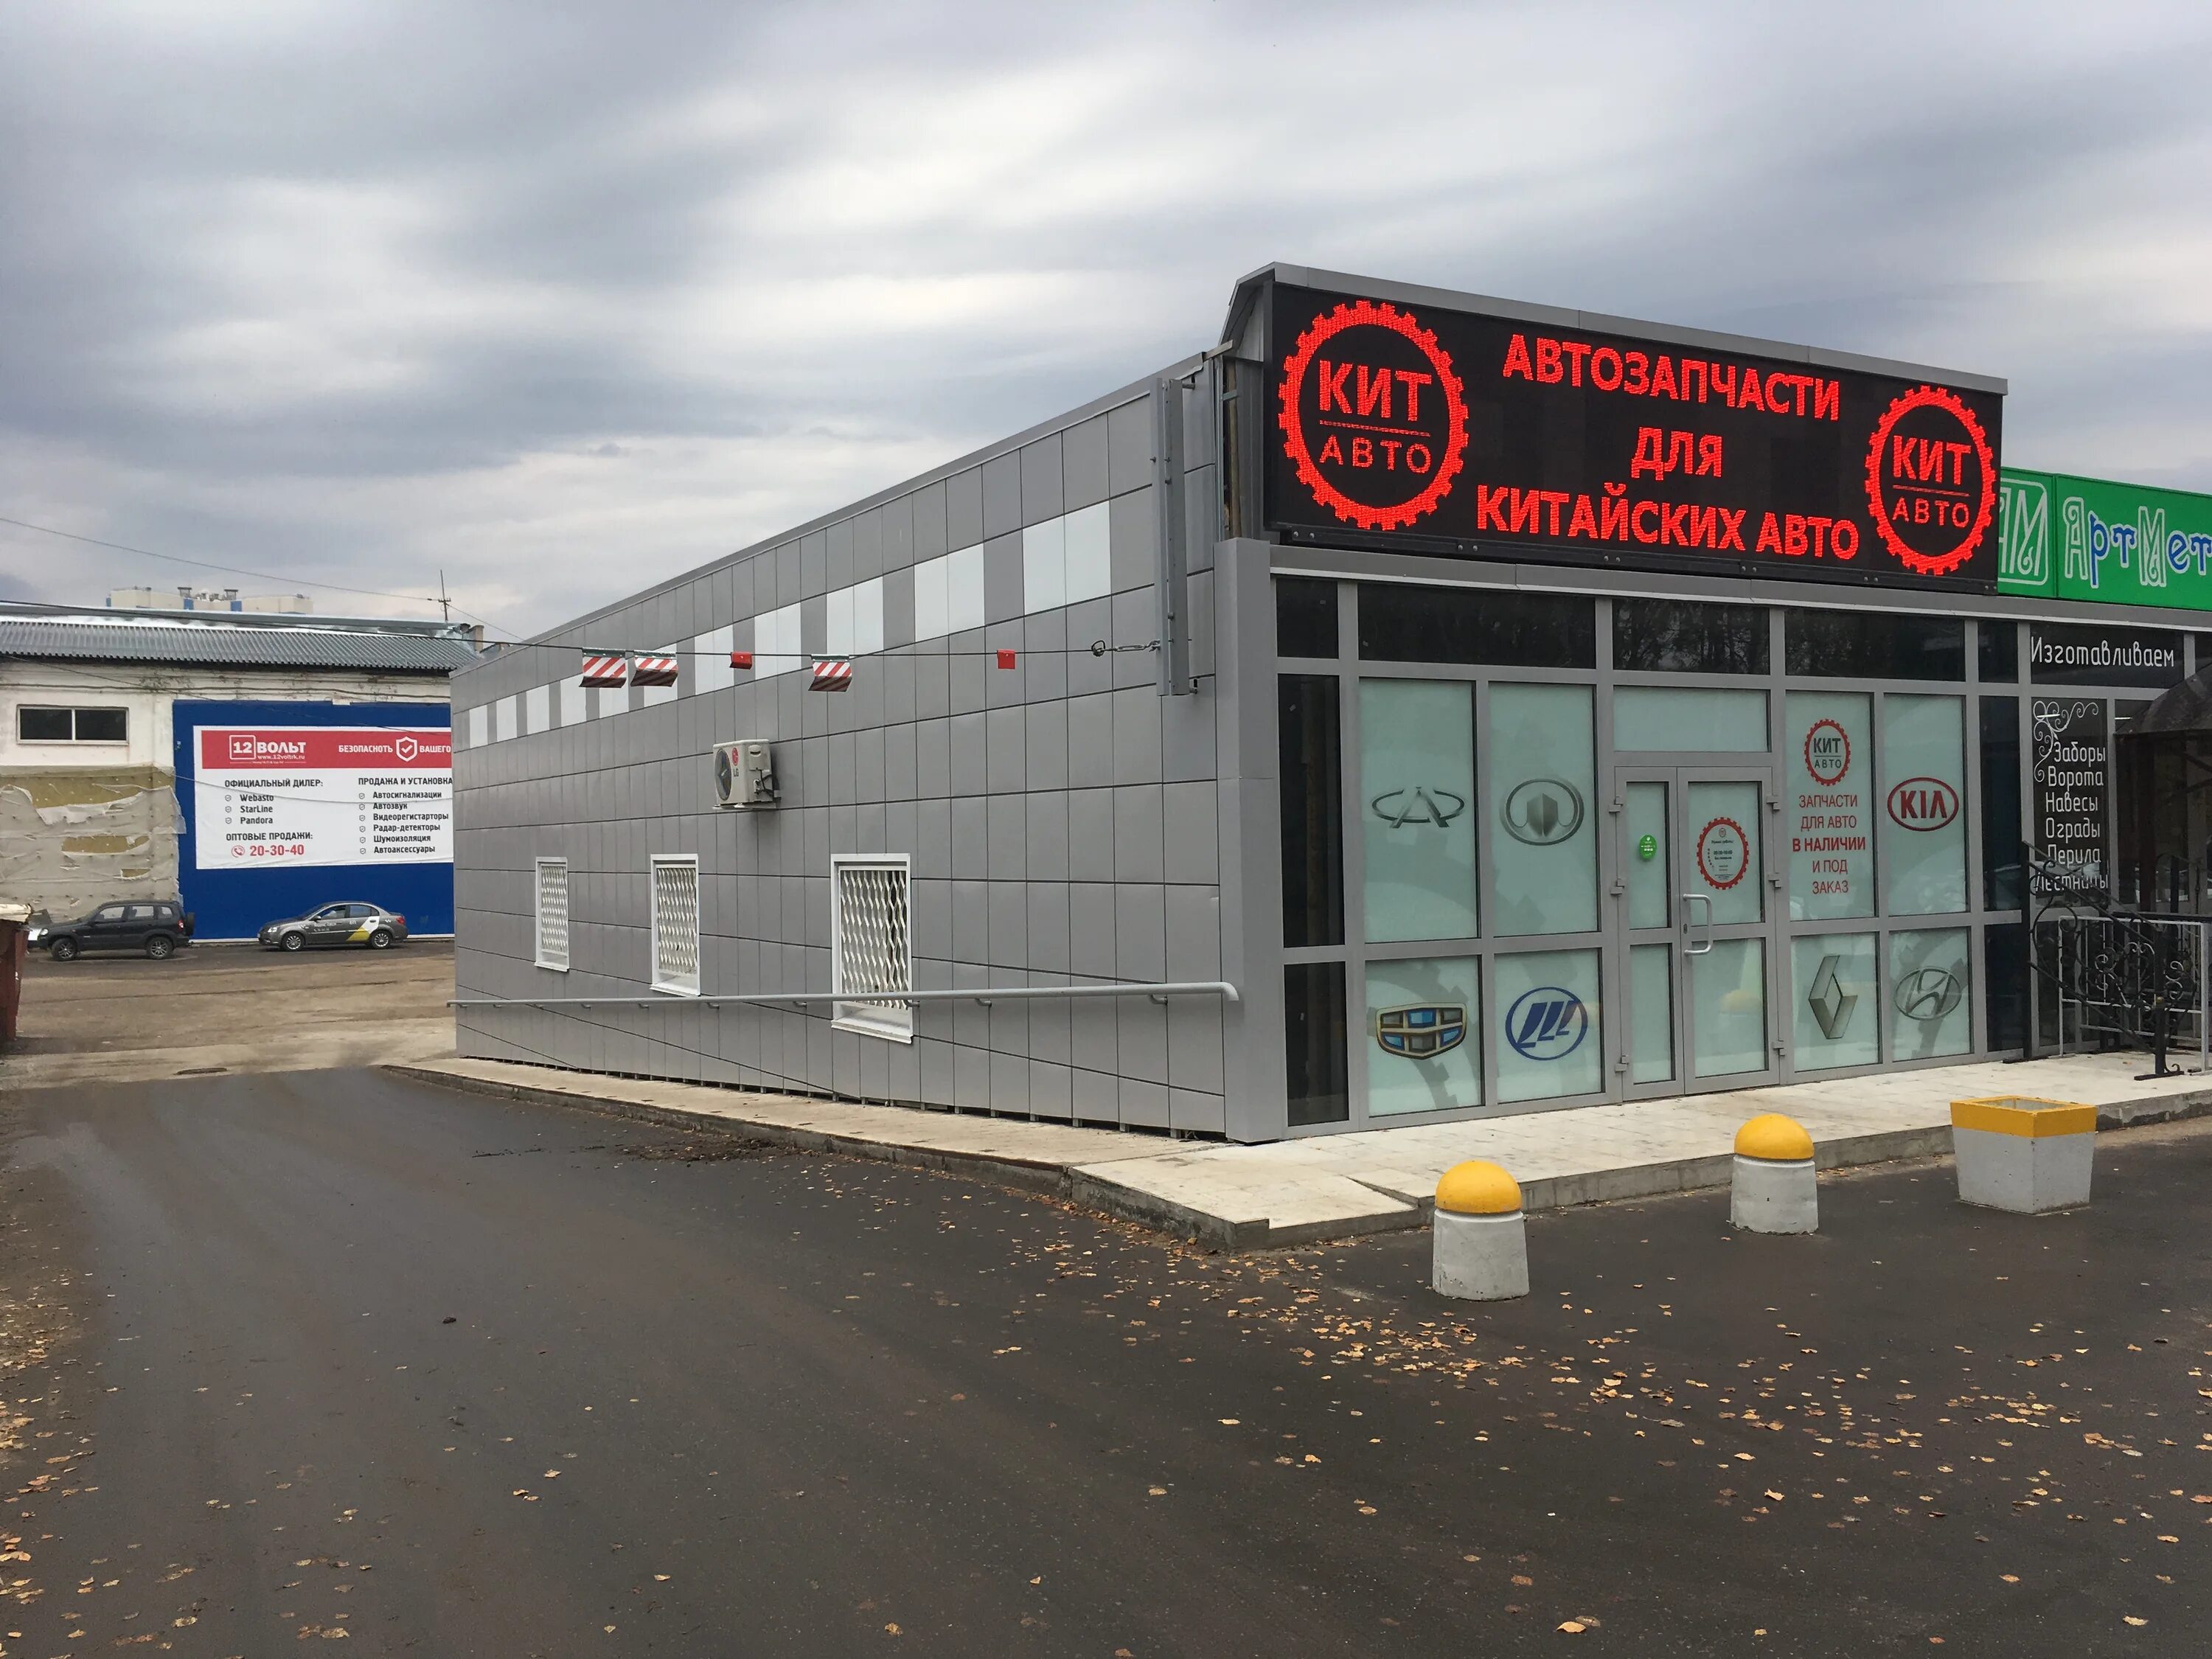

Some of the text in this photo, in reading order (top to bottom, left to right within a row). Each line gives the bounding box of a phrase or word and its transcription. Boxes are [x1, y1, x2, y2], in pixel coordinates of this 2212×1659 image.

[1502, 333, 1840, 421] АВТОЗАПЧАСТИ
[1318, 360, 1432, 423] КИТ
[1318, 436, 1432, 474] АВТО
[1630, 426, 1722, 481] ДЛЯ
[1893, 435, 1971, 485] КИТ
[1892, 497, 1970, 528] АВТО
[1477, 481, 1860, 560] КИТАЙСКИХ АВТО
[2031, 636, 2174, 667] Изготавливаем
[233, 741, 307, 754] 12 ВОЛЬТ
[338, 745, 451, 753] БЕЗОПАСНОТЬ ВАШЕГО
[1813, 737, 1841, 754] КИТ
[2053, 741, 2106, 767] Заборы
[1814, 759, 1842, 768] АВТО
[733, 768, 739, 777] LG
[2048, 765, 2104, 791] Ворота
[224, 779, 324, 788] ОФИЦИАЛЬНЫЙ ДИЛЕР:
[358, 777, 398, 786] ПРОДАЖА
[408, 776, 452, 785] УСТАНОВКА
[240, 794, 274, 802] Webasto
[372, 791, 442, 799] Автосигнализации
[1799, 794, 1858, 808] ЗАПЧАСТИ
[2045, 791, 2098, 813] Навесы
[240, 805, 274, 813] StarLine
[372, 802, 408, 811] Автозвук
[1900, 790, 1948, 819] KIA
[240, 816, 274, 824] Pandora
[373, 813, 449, 822] Видеорегистарторы
[1801, 815, 1857, 832] ДЛЯ АВТО
[373, 824, 441, 832] Радар-детекторы
[2045, 817, 2101, 844] Ограды
[226, 831, 313, 841] ОПТОВЫЕ ПРОДАЖИ:
[373, 835, 431, 844] Шумоизоляция
[249, 844, 305, 857] 20-30-40
[374, 846, 436, 854] Автоаксессуары
[1792, 836, 1866, 852] В НАЛИЧИИ
[2048, 844, 2101, 869] Перила
[1812, 859, 1848, 874] И ПОД
[1812, 880, 1849, 894] ЗАКАЗ
